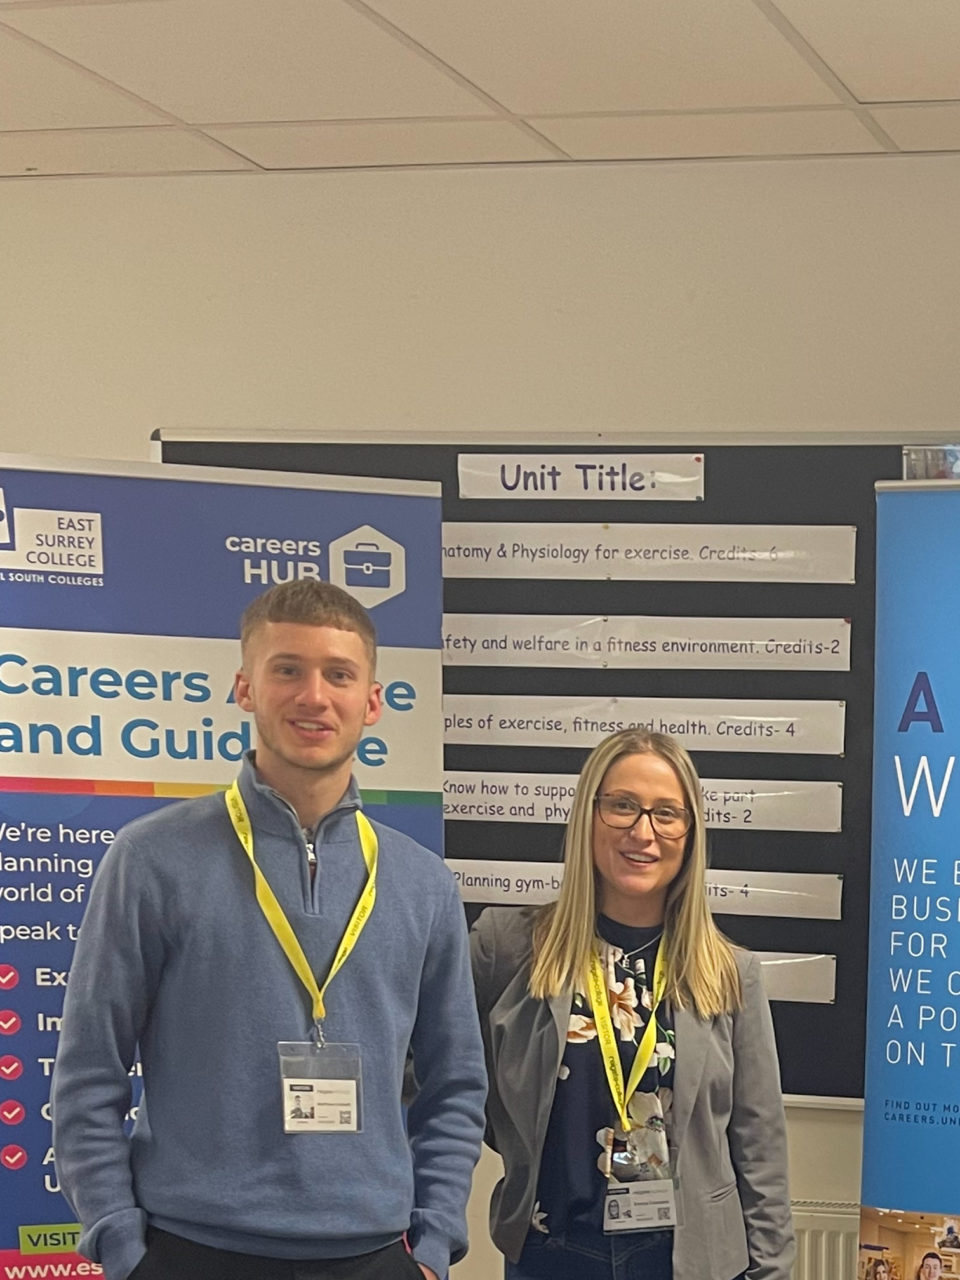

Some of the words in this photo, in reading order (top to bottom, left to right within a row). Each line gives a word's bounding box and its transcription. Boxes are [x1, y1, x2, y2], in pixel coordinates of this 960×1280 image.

[500, 463, 562, 492] Unit
[575, 463, 657, 492] Title:
[57, 517, 95, 531] EAST
[36, 533, 95, 550] SURREY
[225, 534, 321, 557] careers
[26, 551, 96, 567] COLLEGE
[497, 544, 508, 559] &
[511, 544, 590, 565] Physiology
[595, 545, 619, 561] for
[624, 546, 694, 561] exercise.
[768, 545, 778, 561] 6
[9, 573, 44, 583] SOUTH
[48, 575, 104, 587] COLLEGES
[243, 560, 321, 584] HUB
[441, 634, 477, 653] fety
[482, 635, 508, 651] and
[512, 636, 570, 652] welfare
[575, 637, 589, 652] in
[593, 641, 602, 653] a
[607, 637, 657, 653] fitness
[661, 640, 760, 655] environment.
[0, 653, 211, 704] Careers
[897, 671, 944, 733] A
[477, 715, 494, 731] of
[498, 717, 567, 734] exercise,
[573, 717, 624, 732] fitness
[659, 718, 712, 736] health.
[785, 722, 796, 738] 4
[0, 715, 102, 757] and
[120, 716, 389, 768] Guide
[481, 779, 509, 795] how
[514, 782, 529, 796] to
[443, 802, 505, 817] exercise
[509, 802, 535, 817] and
[743, 809, 753, 824] 2
[58, 823, 116, 845] here
[454, 872, 512, 893] Planning
[893, 858, 938, 886] WE
[60, 884, 85, 903] of
[349, 906, 368, 937] VISITOR
[890, 931, 947, 960] FOR
[888, 968, 932, 995] WE
[887, 1003, 904, 1030] A
[885, 1039, 926, 1066] ON
[884, 1099, 910, 1111] FIND
[915, 1102, 938, 1113] OUT
[27, 1232, 80, 1248] VISIT
